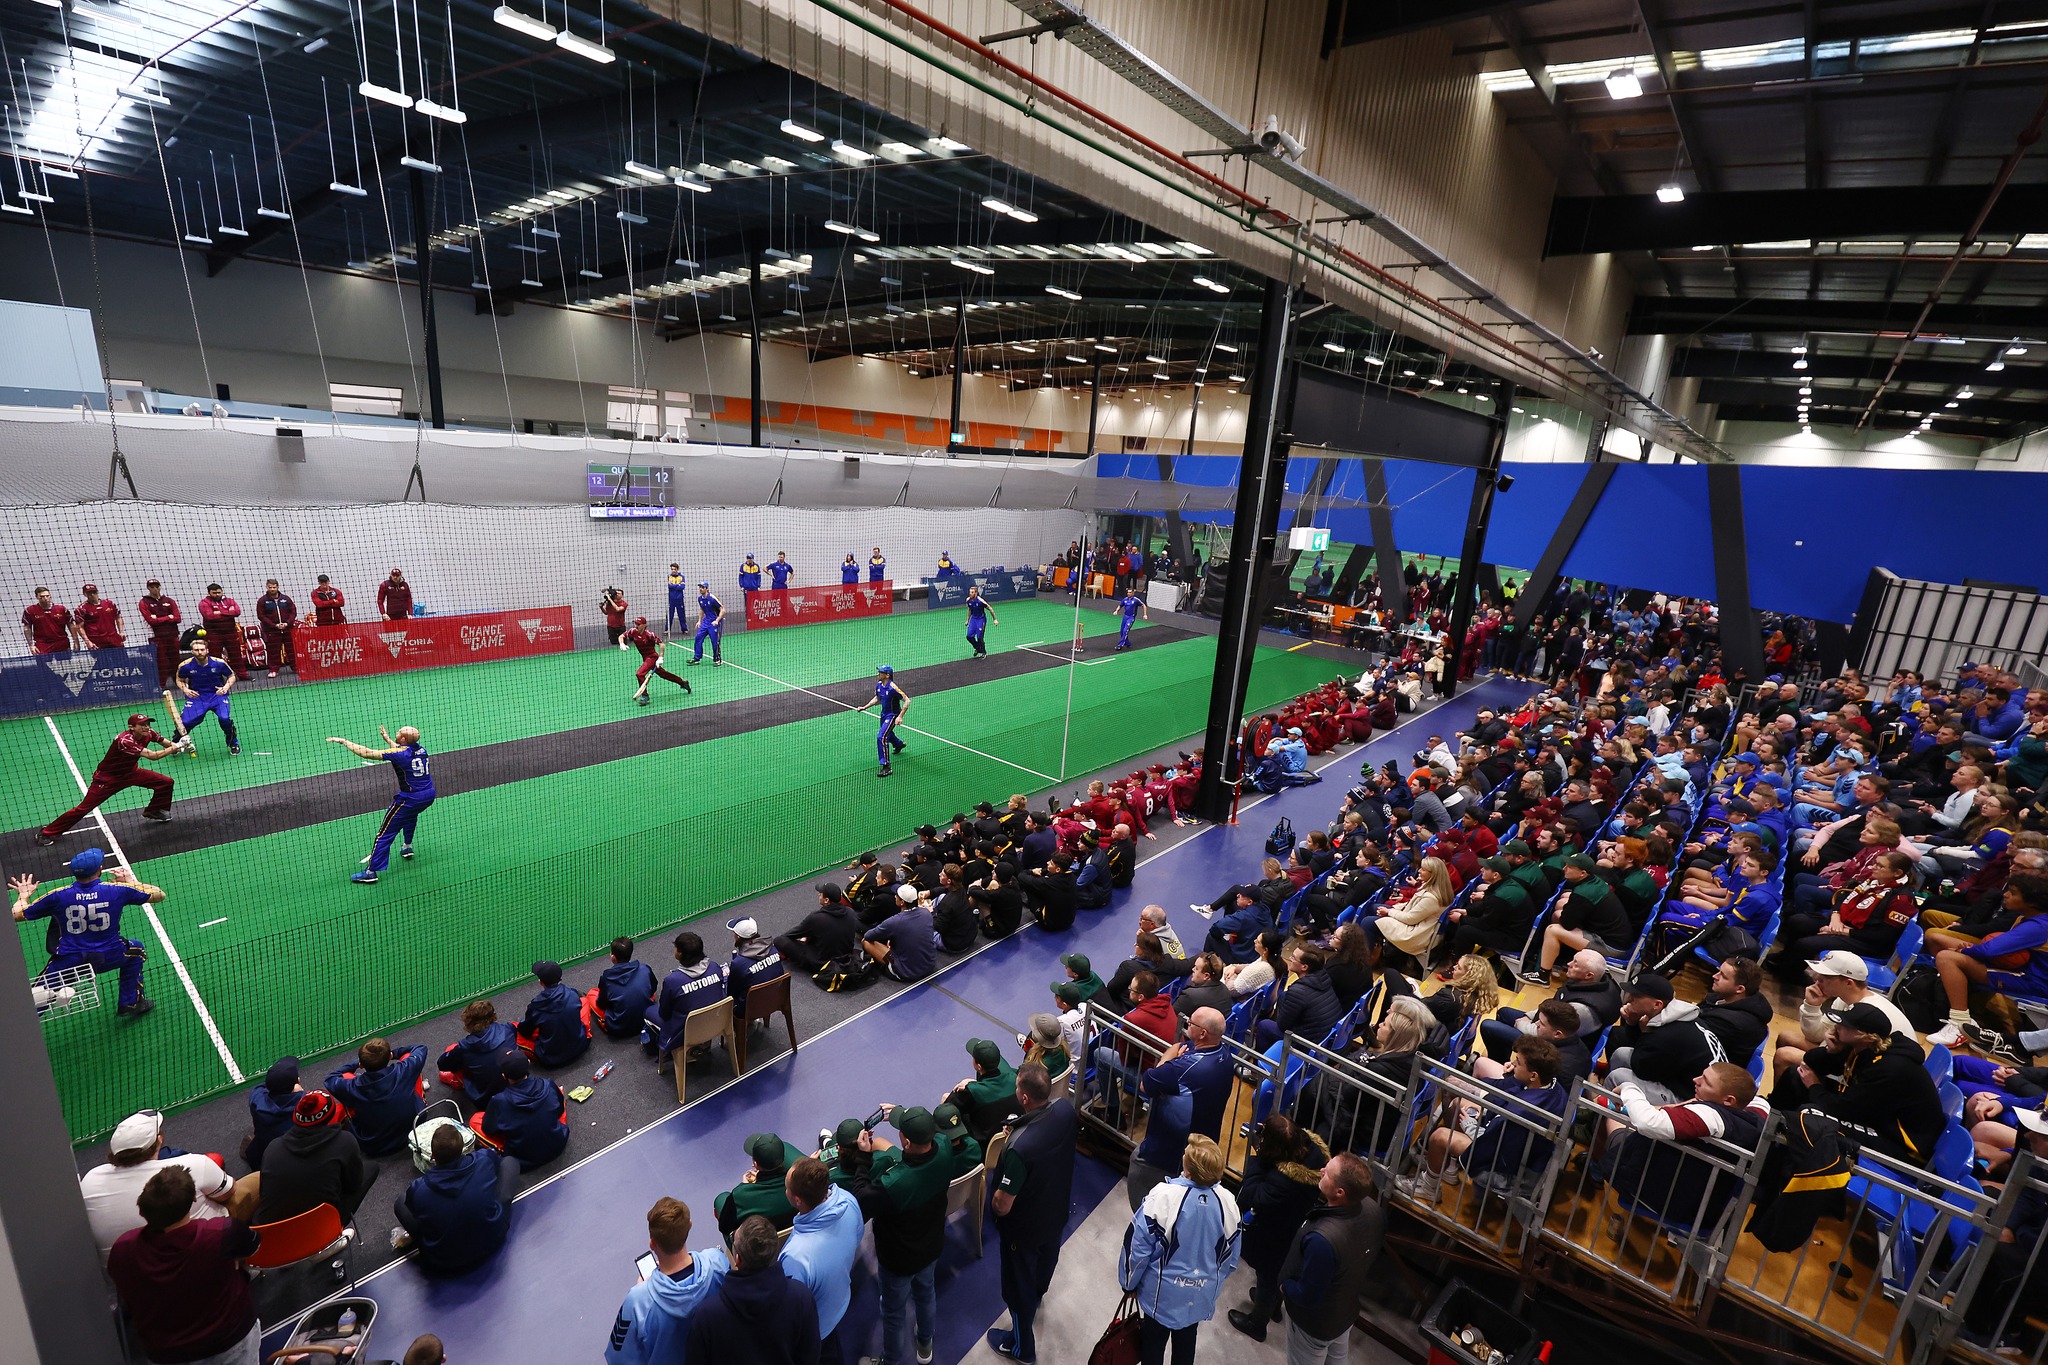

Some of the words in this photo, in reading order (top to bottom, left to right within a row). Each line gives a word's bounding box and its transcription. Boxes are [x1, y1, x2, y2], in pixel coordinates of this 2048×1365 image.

[592, 477, 602, 485] 12
[654, 472, 669, 483] 12
[753, 598, 781, 609] CHANGE
[759, 608, 781, 620] GAME
[460, 623, 504, 639] CHANGE
[307, 636, 361, 653] CHANGE
[471, 634, 506, 652] GAME
[320, 649, 363, 668] GAME
[76, 892, 98, 901] RYAN
[65, 901, 110, 935] 85
[681, 973, 720, 995] VICTORIA
[1173, 1276, 1208, 1288] NSW
